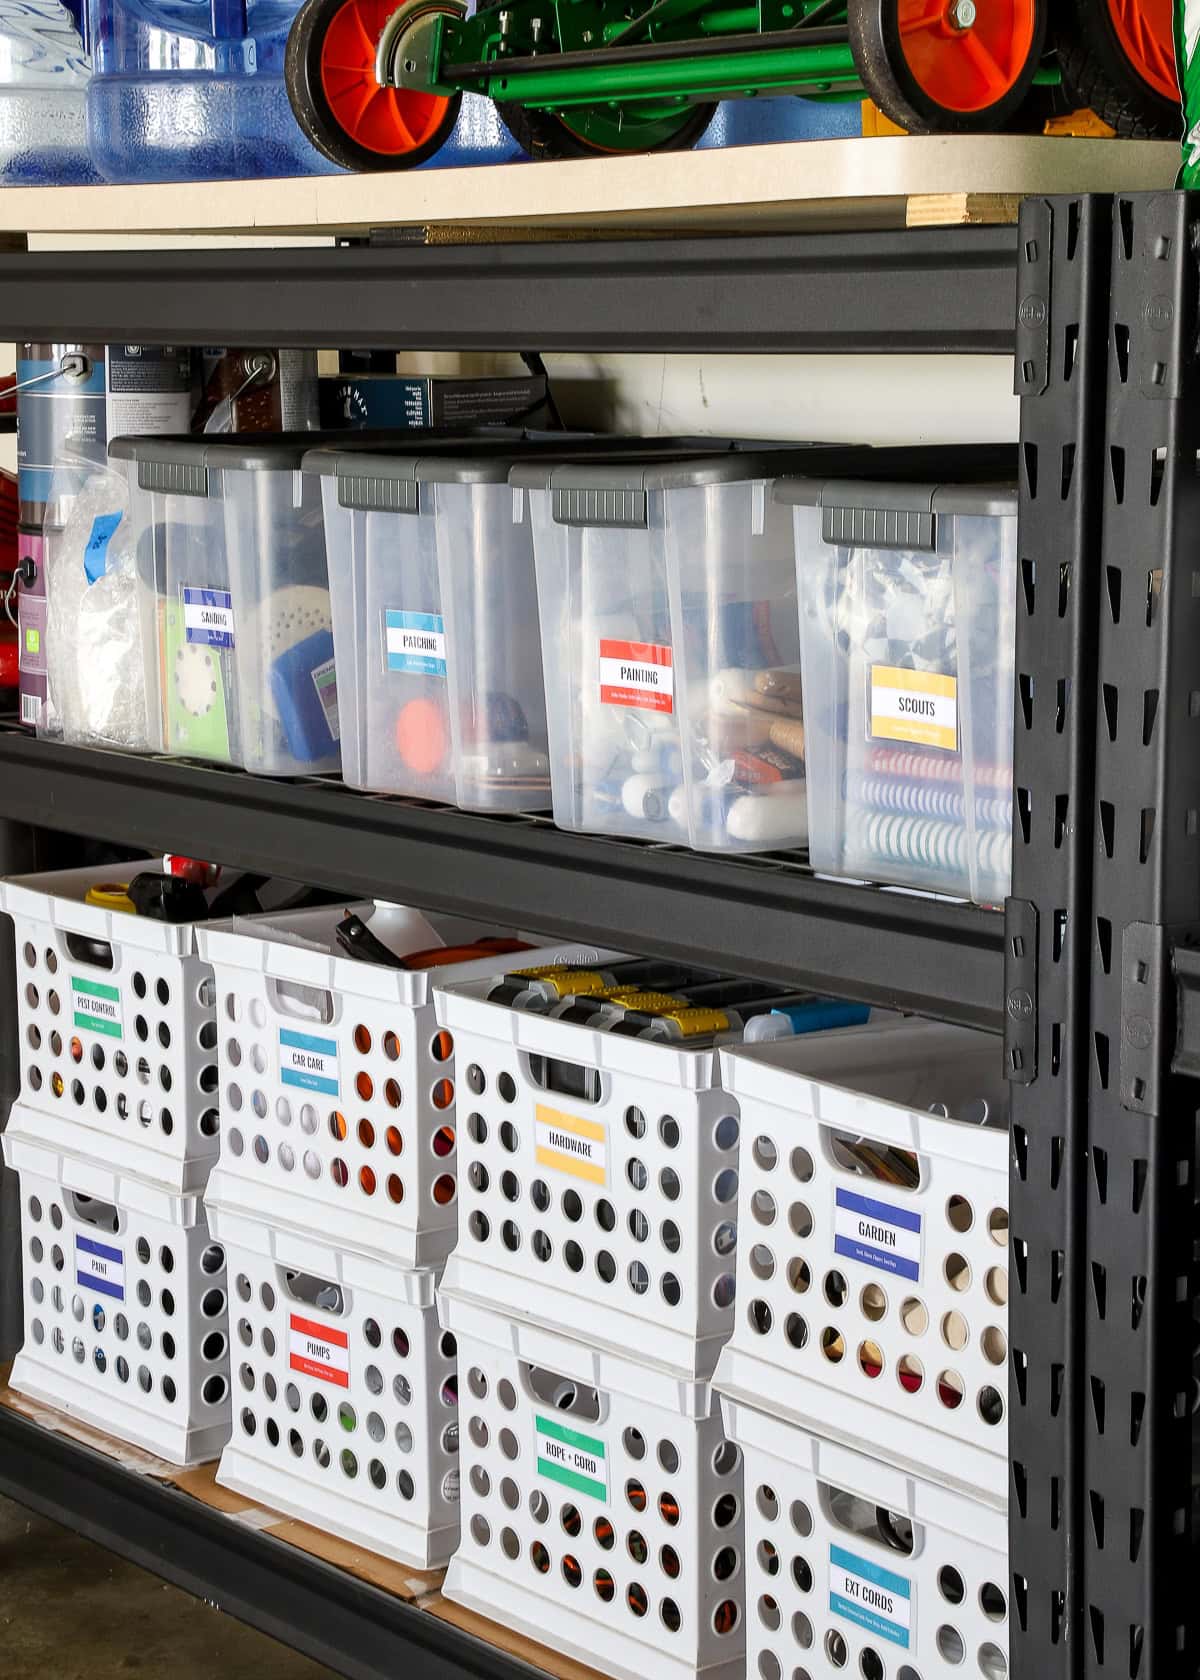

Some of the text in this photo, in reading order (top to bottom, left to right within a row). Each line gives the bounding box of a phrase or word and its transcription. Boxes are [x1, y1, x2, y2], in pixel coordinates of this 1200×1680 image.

[403, 634, 437, 651] PATCHING
[620, 666, 658, 685] PAINTING
[898, 696, 935, 717] SCOUTS
[77, 996, 116, 1017] PEST CONTROL
[292, 1053, 324, 1072] CAR CARE
[549, 1130, 592, 1158] HARDWARE
[858, 1220, 896, 1247] GARDEN
[91, 1259, 107, 1276] PAINT
[307, 1341, 331, 1361] PUMPS
[546, 1441, 566, 1461] ROPE
[574, 1453, 597, 1474] CORD
[845, 1577, 894, 1614] EXT CORDS
